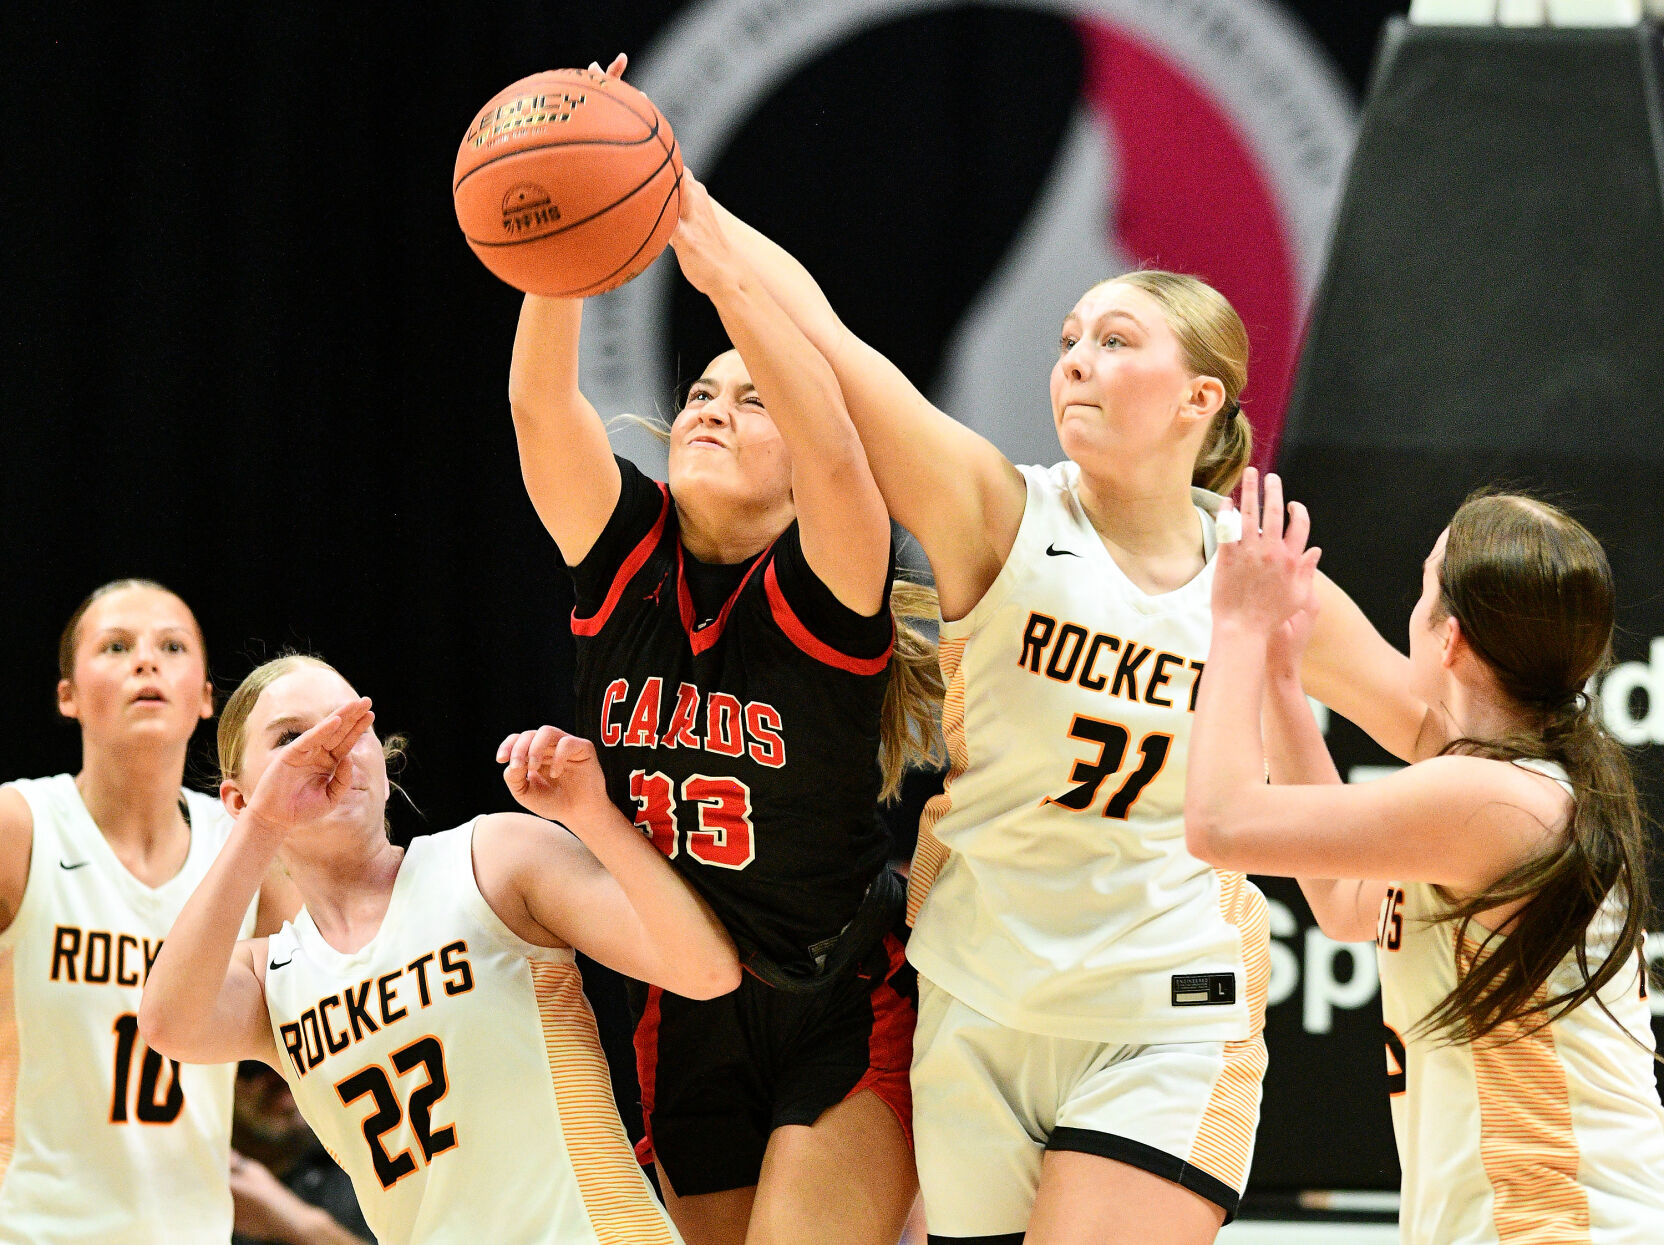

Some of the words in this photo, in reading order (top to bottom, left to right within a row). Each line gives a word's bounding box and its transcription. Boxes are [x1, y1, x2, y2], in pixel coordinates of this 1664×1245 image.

[1018, 610, 1206, 713] ROCKET
[600, 676, 787, 769] CARDS
[1039, 712, 1175, 821] 31
[629, 769, 756, 871] 33
[279, 939, 475, 1079] ROCKETS
[1218, 982, 1224, 995] L
[109, 1012, 185, 1125] 10
[333, 1034, 459, 1192] 22
